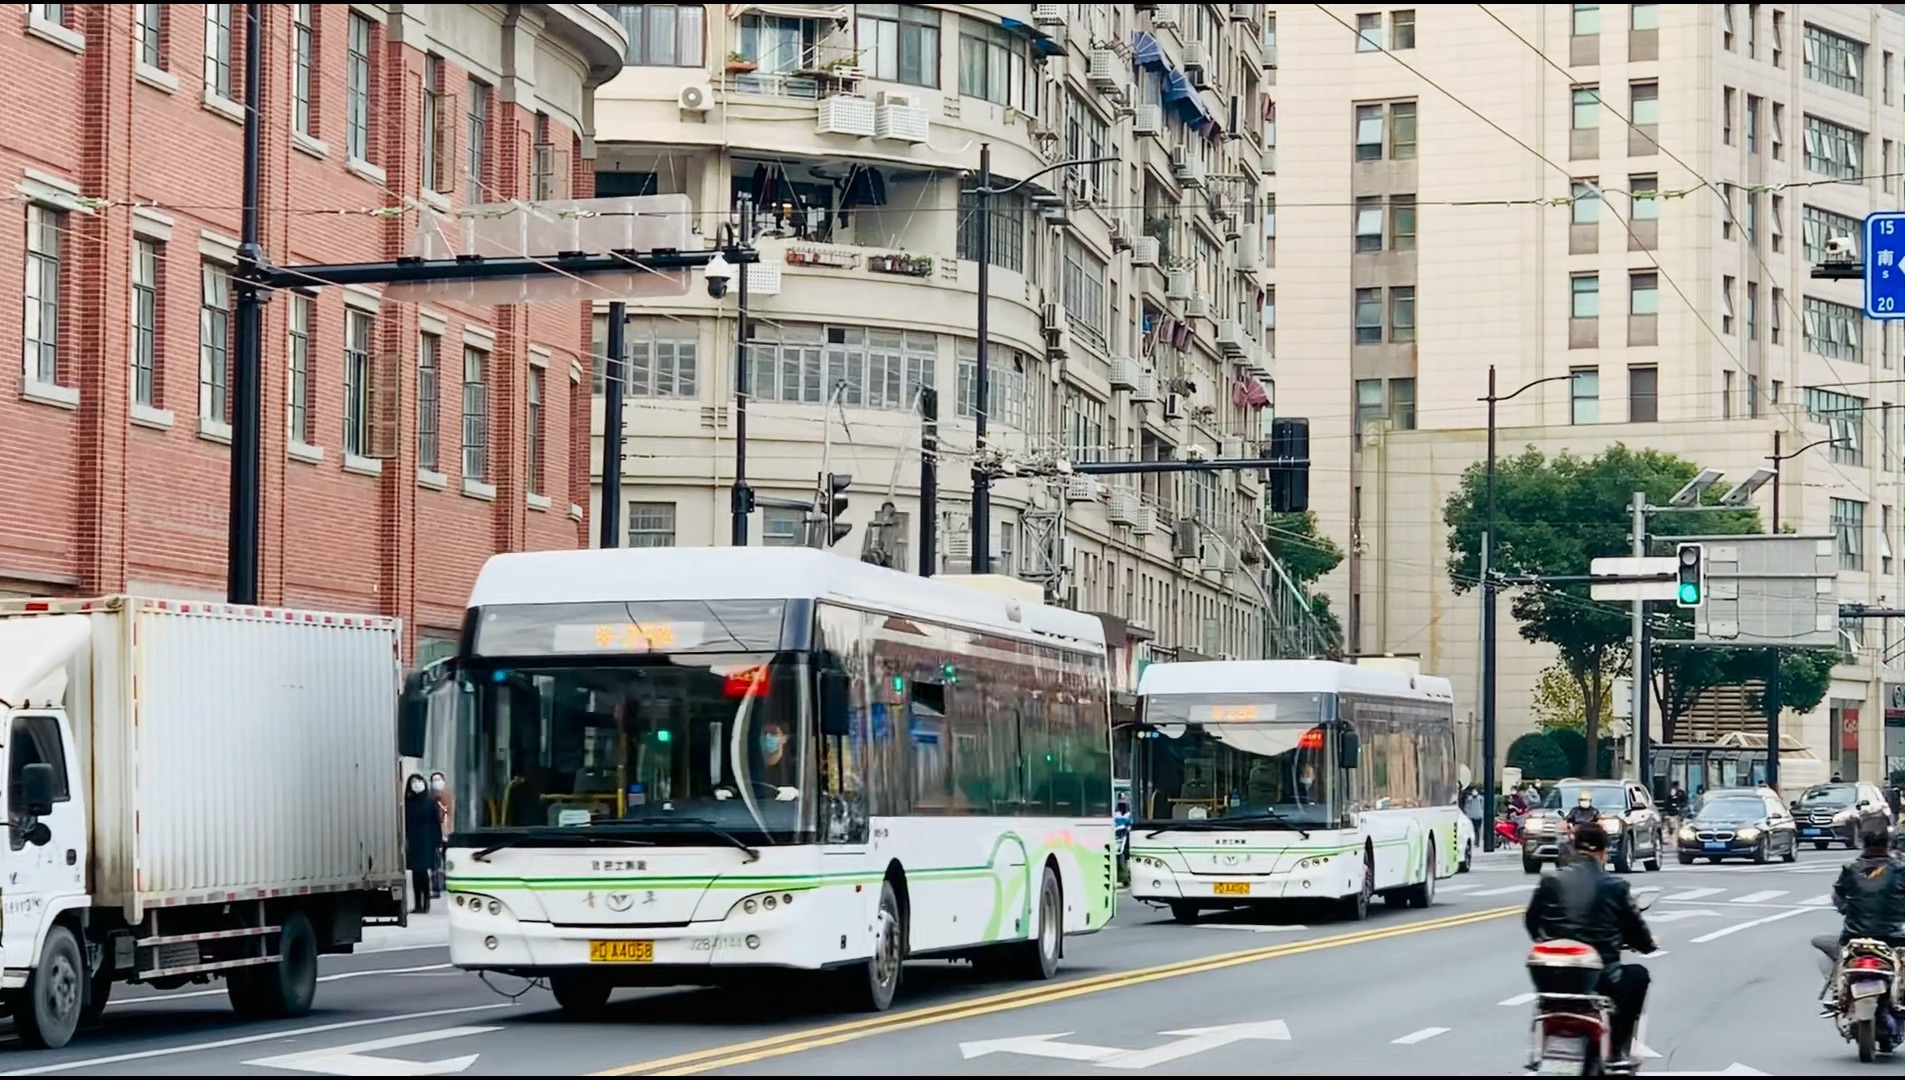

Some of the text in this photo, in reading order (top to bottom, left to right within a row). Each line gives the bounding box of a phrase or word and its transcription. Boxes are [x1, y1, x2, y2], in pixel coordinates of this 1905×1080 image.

[1880, 220, 1895, 235] 15
[1877, 249, 1895, 267] 南
[1877, 297, 1895, 311] 20
